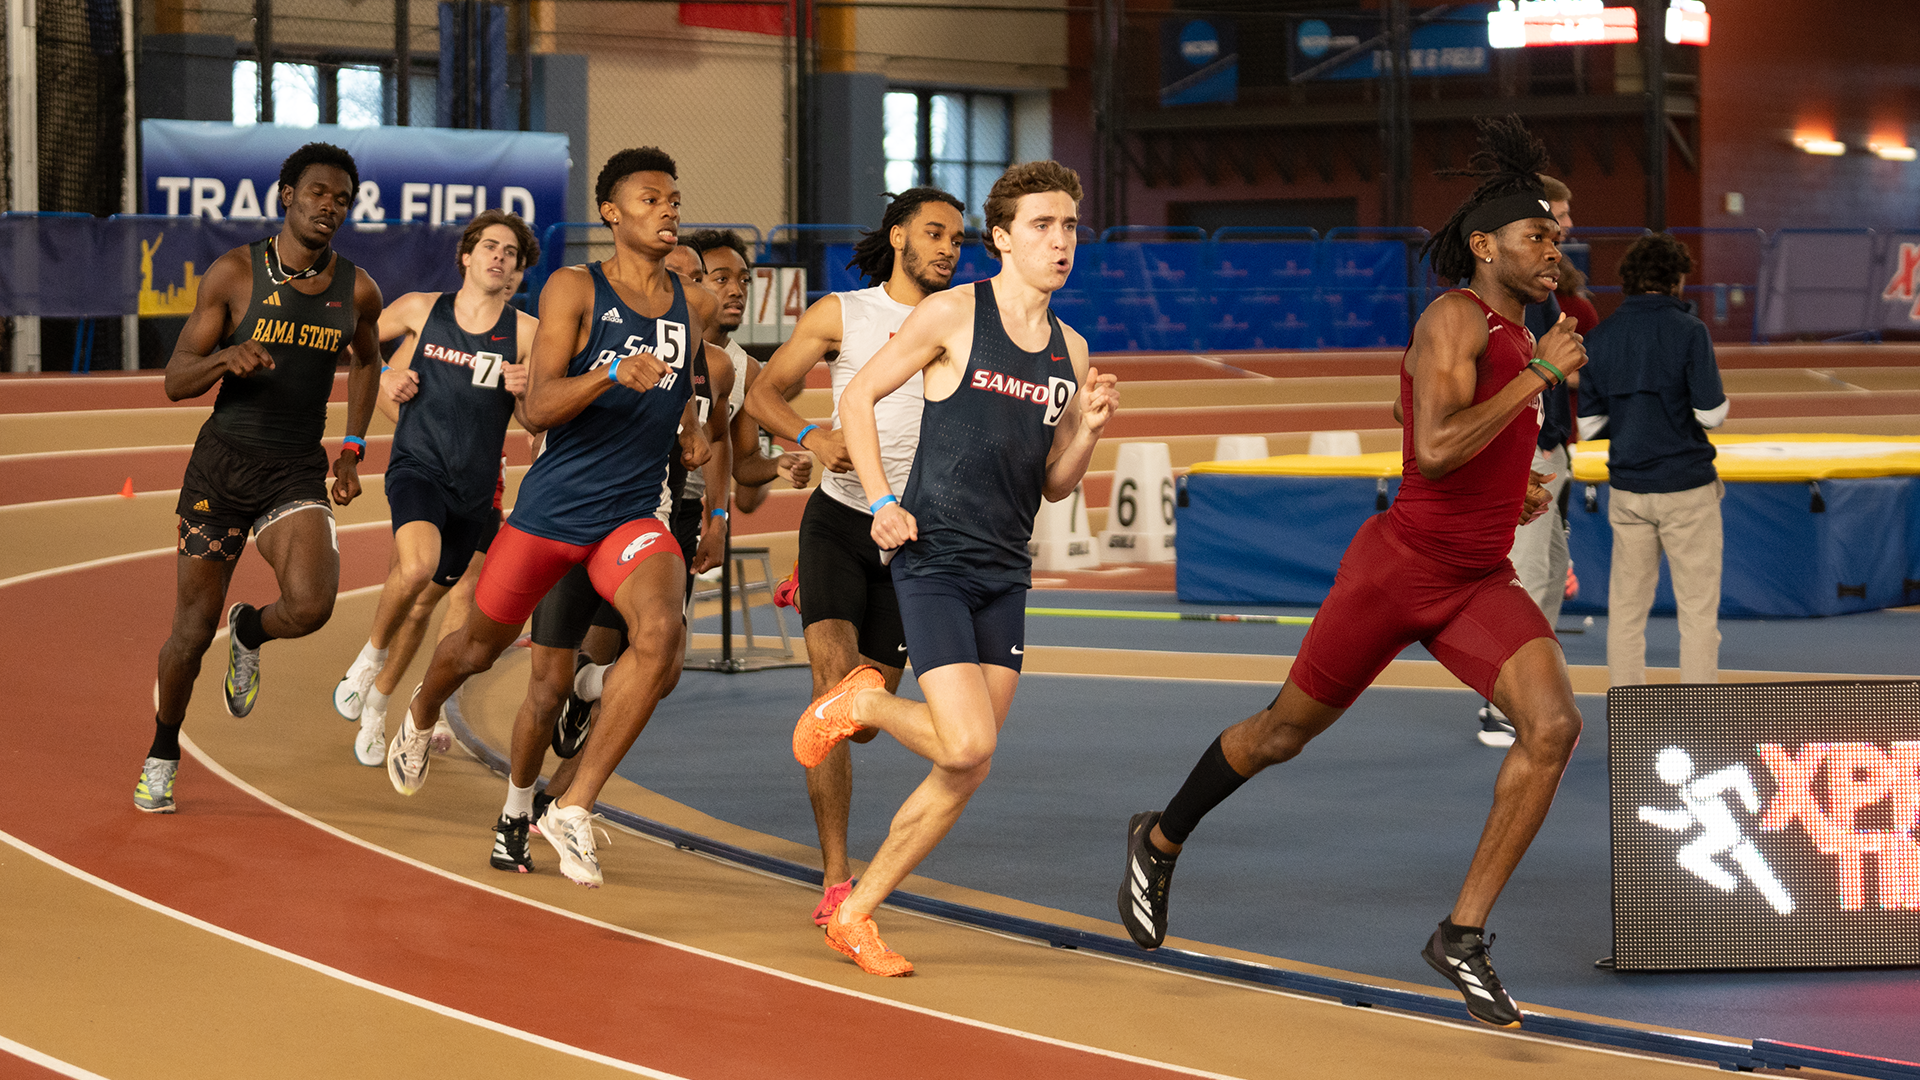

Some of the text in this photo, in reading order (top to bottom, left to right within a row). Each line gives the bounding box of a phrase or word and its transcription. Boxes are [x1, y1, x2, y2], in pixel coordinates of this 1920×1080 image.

[156, 176, 280, 220] TRA
[352, 180, 387, 222] &
[251, 318, 342, 353] BAMA STATE
[663, 323, 679, 363] 5
[423, 343, 478, 369] SAMF
[480, 354, 496, 384] 7
[970, 369, 1050, 405] SAMFO
[1050, 381, 1069, 423] 9
[1118, 477, 1138, 527] 6
